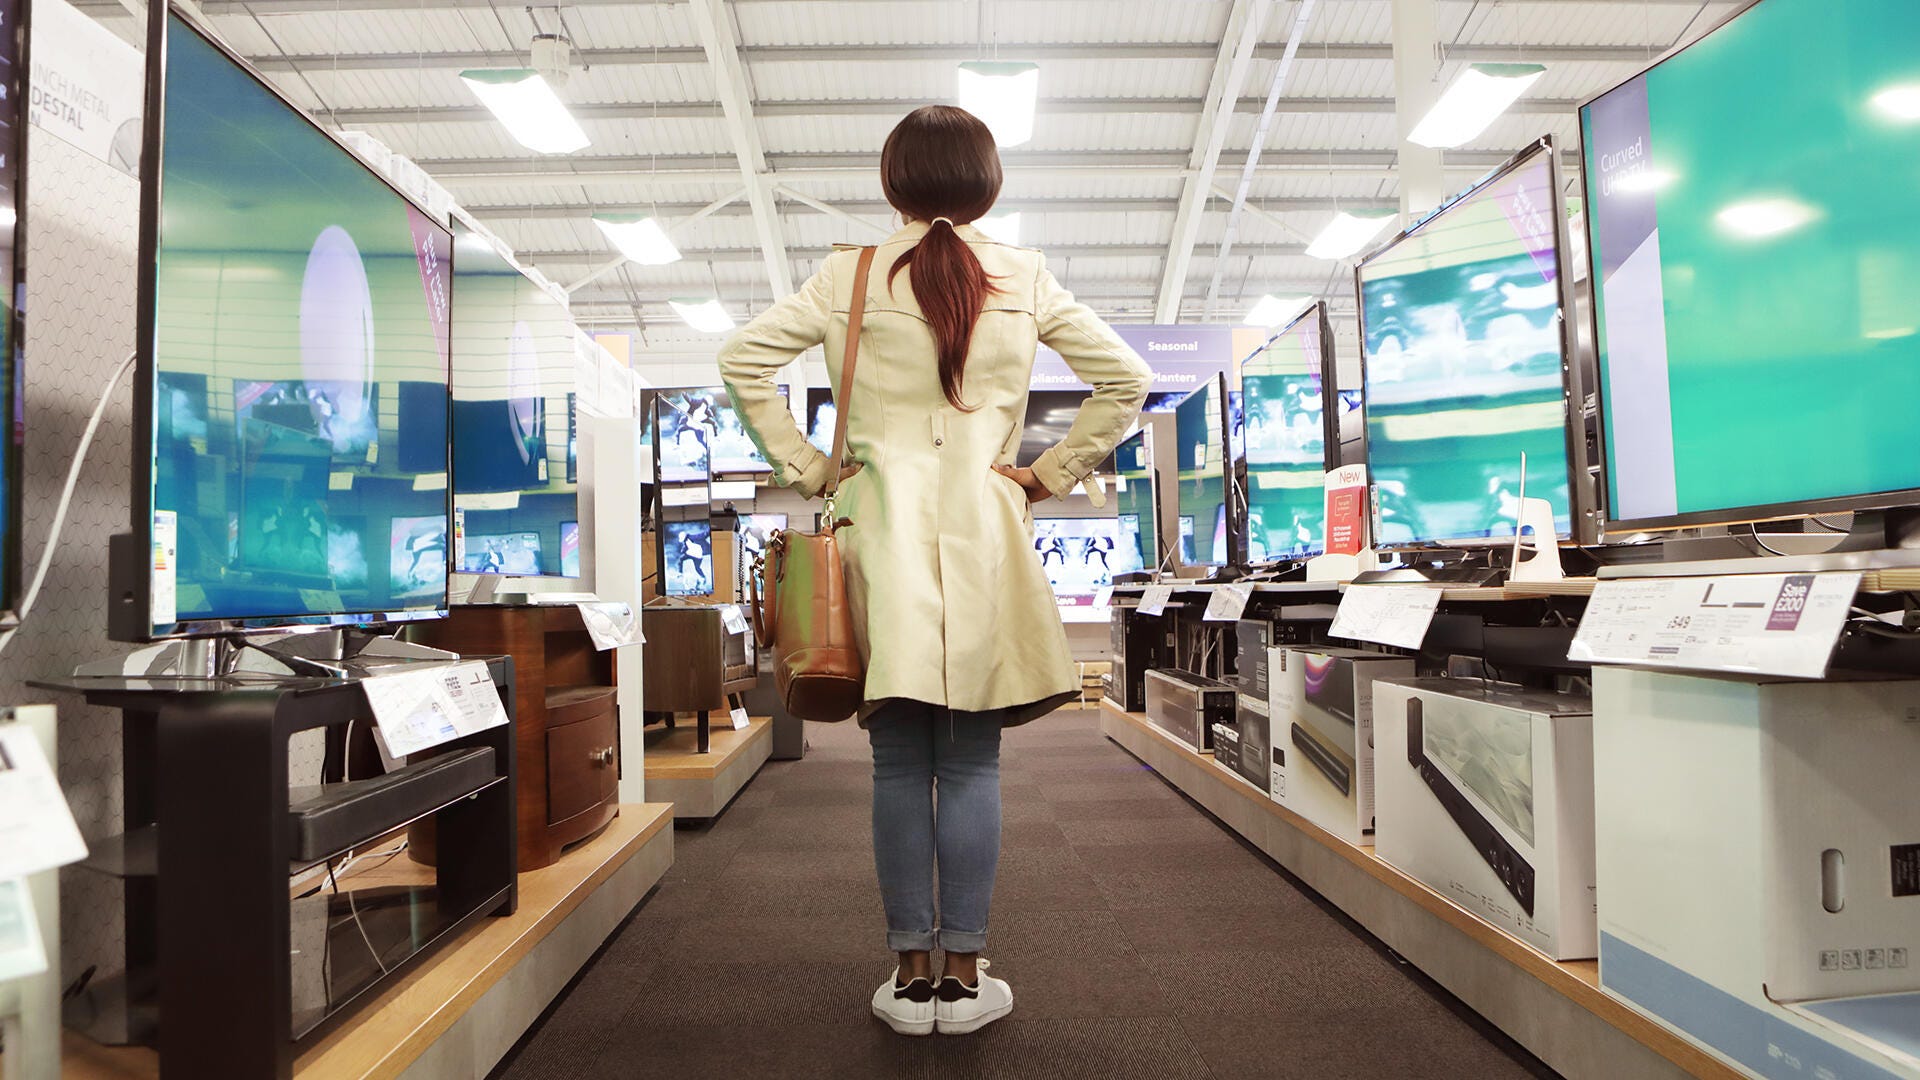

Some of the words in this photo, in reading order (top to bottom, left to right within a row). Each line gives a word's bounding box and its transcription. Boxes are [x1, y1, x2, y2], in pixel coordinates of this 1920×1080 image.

[33, 62, 68, 96] INCH
[71, 83, 111, 122] METAL
[31, 85, 84, 132] DESTAL
[1601, 136, 1642, 172] Curved
[422, 239, 433, 275] Pay
[430, 277, 443, 323] Later
[427, 232, 438, 269] Buy
[435, 271, 446, 309] now
[1148, 341, 1198, 352] Seasonal
[1151, 372, 1197, 383] Planters
[1339, 471, 1361, 484] New
[1782, 583, 1808, 597] Save
[1774, 597, 1804, 612] £200
